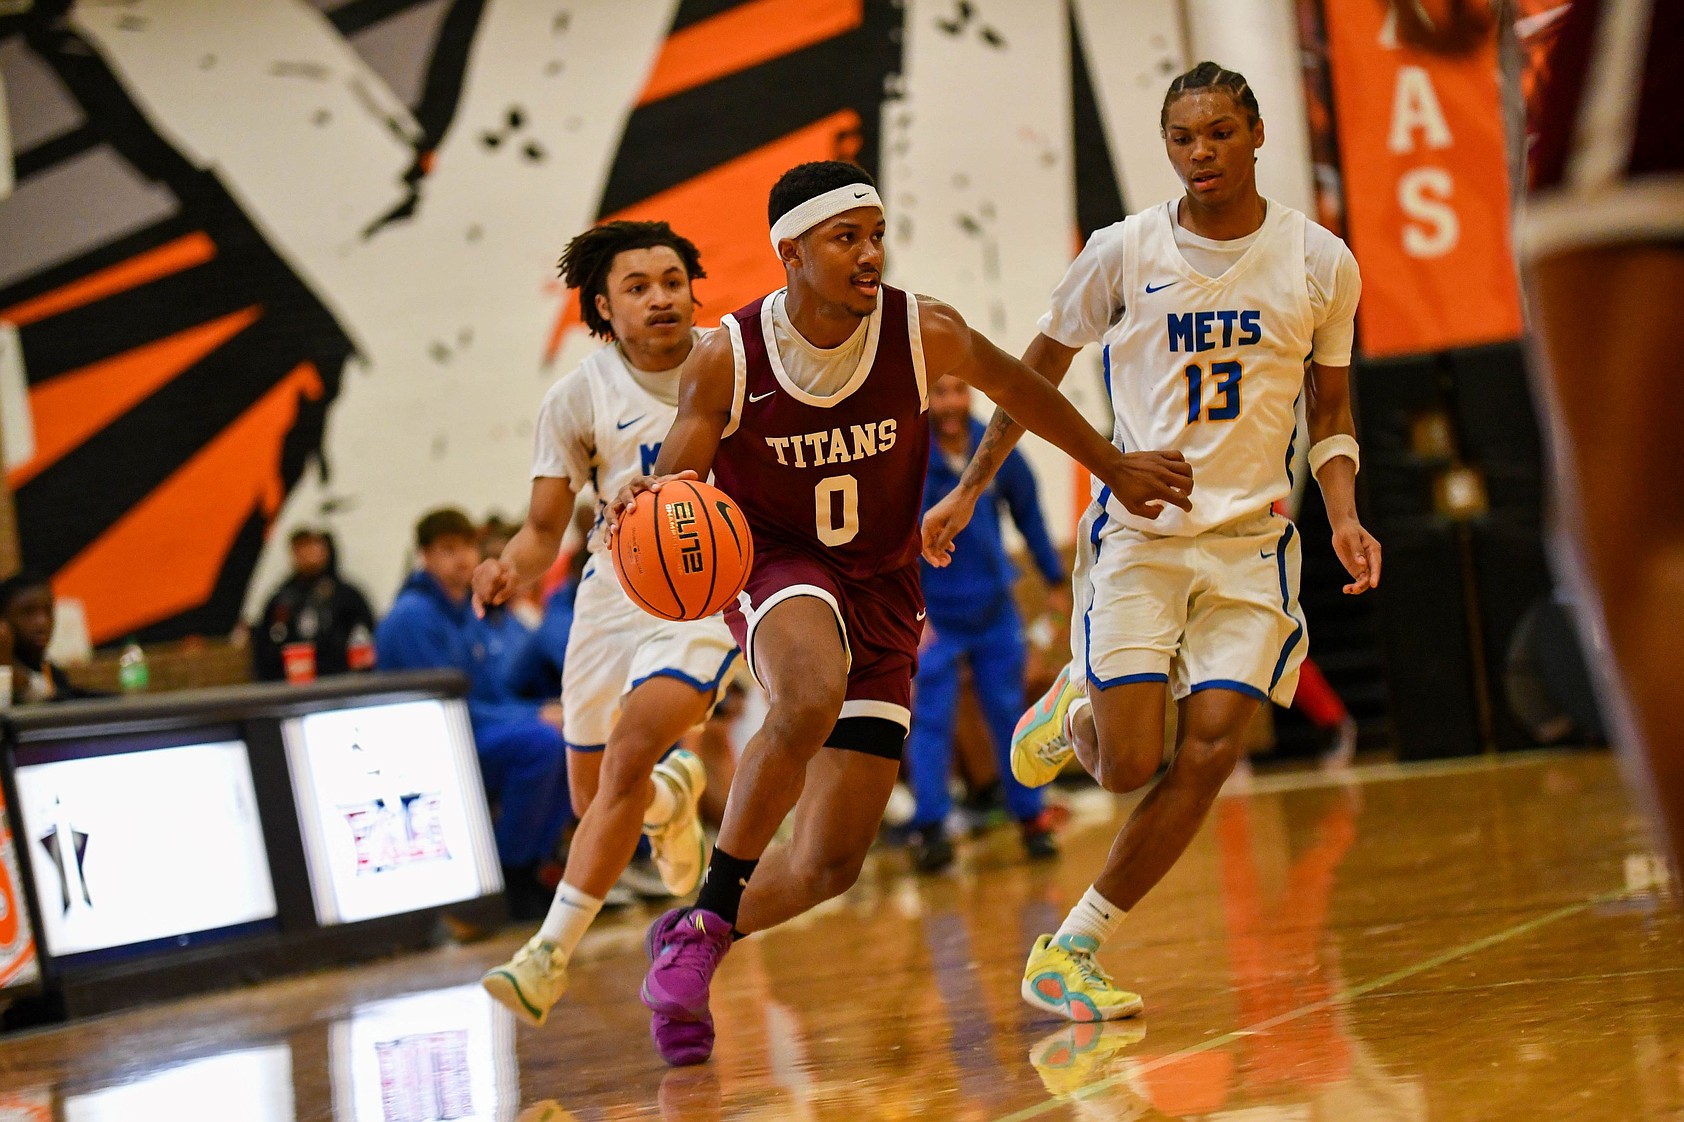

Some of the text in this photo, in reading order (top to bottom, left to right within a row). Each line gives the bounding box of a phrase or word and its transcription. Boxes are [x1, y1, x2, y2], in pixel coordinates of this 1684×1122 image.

[1167, 310, 1262, 352] METS
[1183, 357, 1245, 428] 13
[764, 418, 897, 468] TITANS
[671, 501, 704, 574] ELITE
[814, 474, 859, 547] 0
